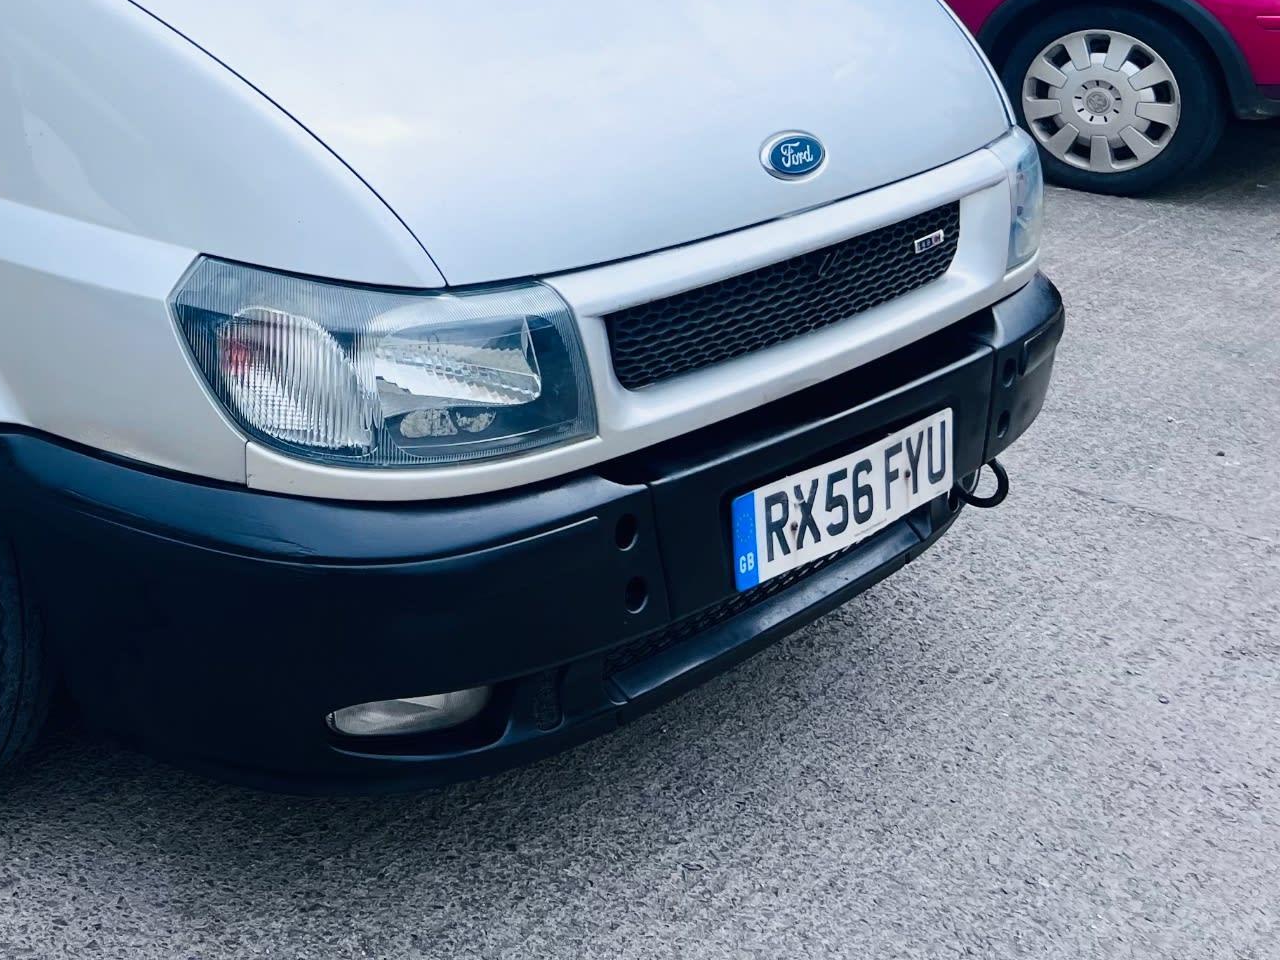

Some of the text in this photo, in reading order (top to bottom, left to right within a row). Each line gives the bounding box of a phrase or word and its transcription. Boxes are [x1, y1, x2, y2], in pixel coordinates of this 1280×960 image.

[780, 141, 814, 168] Ford
[765, 419, 947, 563] RX56 FYU
[739, 551, 755, 575] GB
